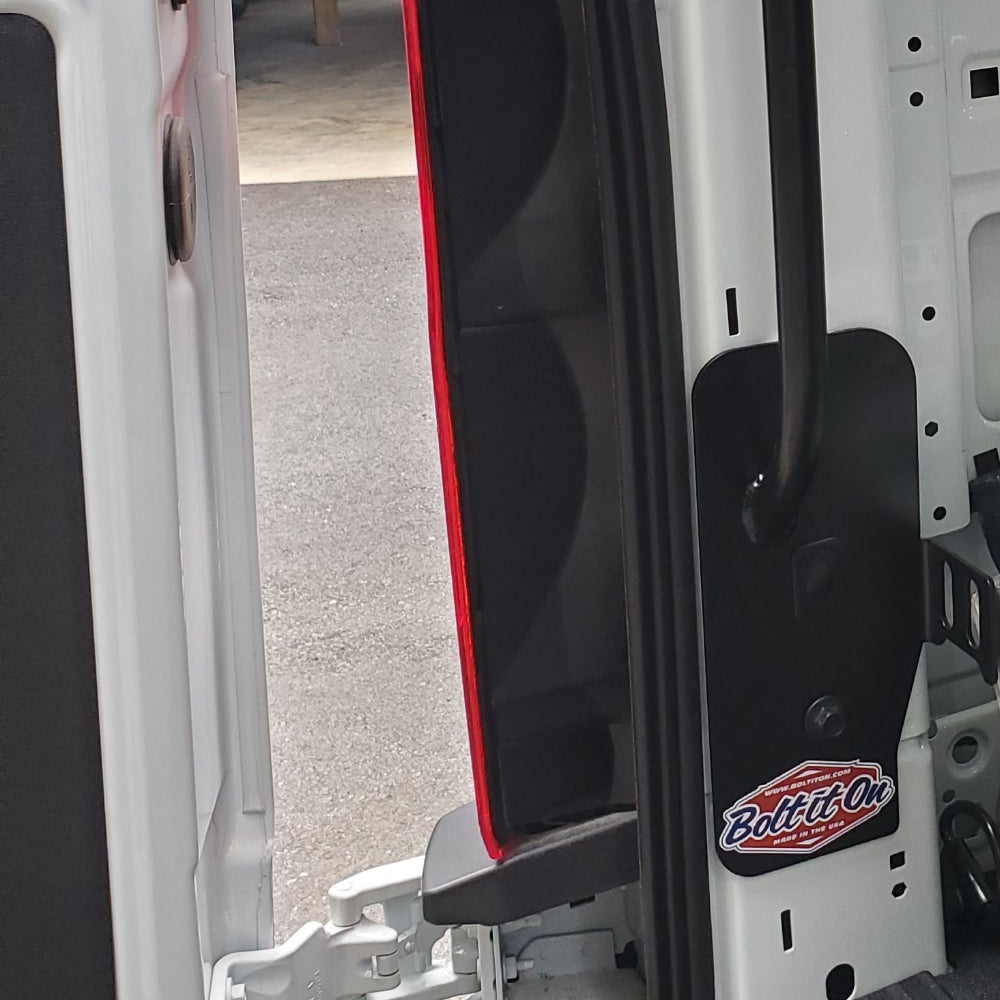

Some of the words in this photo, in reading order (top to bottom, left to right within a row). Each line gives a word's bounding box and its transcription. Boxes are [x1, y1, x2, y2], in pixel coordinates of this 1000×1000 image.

[764, 768, 851, 796] WWW.BOLTITON.COM
[725, 794, 806, 845] Bolt
[803, 782, 845, 825] it
[844, 777, 893, 812] On
[773, 834, 797, 845] MADE
[800, 829, 808, 837] IN
[811, 825, 825, 835] THE
[829, 820, 845, 830] USA
